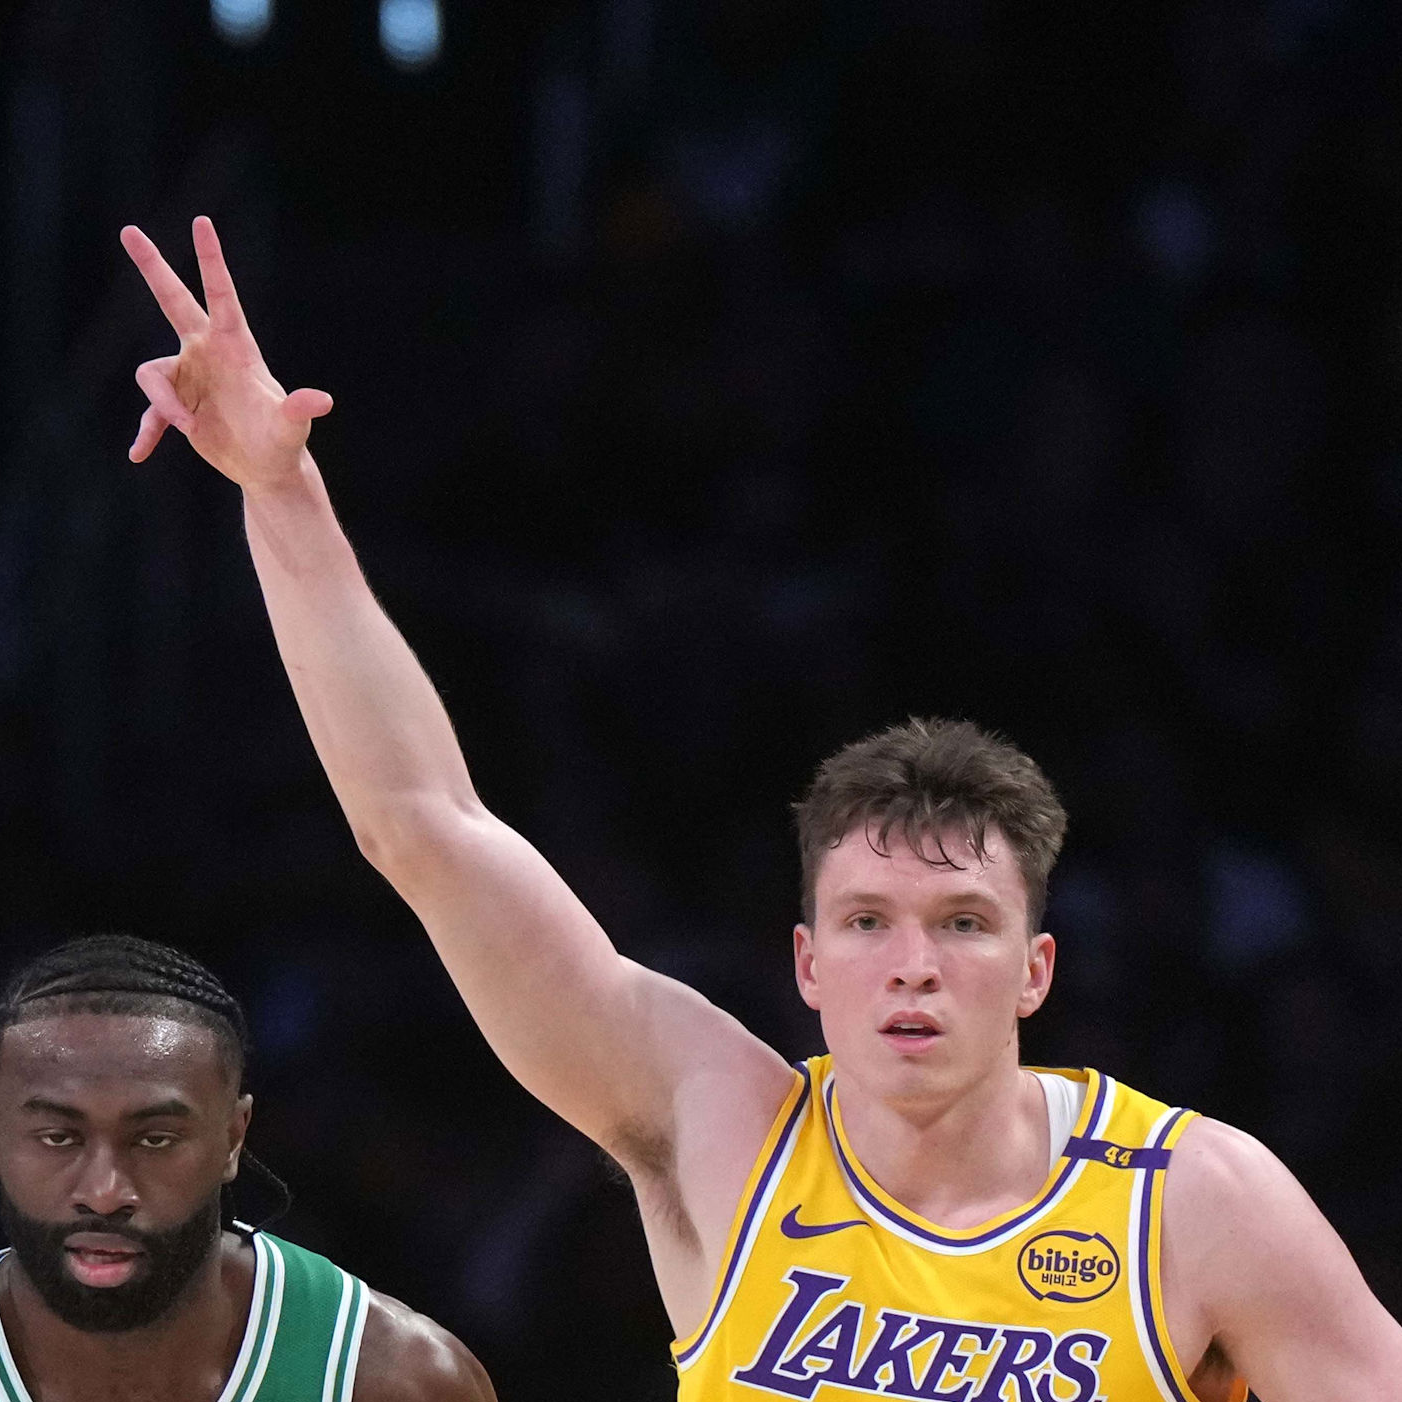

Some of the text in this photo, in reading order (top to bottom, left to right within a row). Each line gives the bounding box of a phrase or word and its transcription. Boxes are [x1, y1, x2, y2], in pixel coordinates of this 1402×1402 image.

[1105, 1147, 1133, 1166] 44
[1029, 1249, 1114, 1282] bibigo
[1041, 1273, 1077, 1287] 비비고
